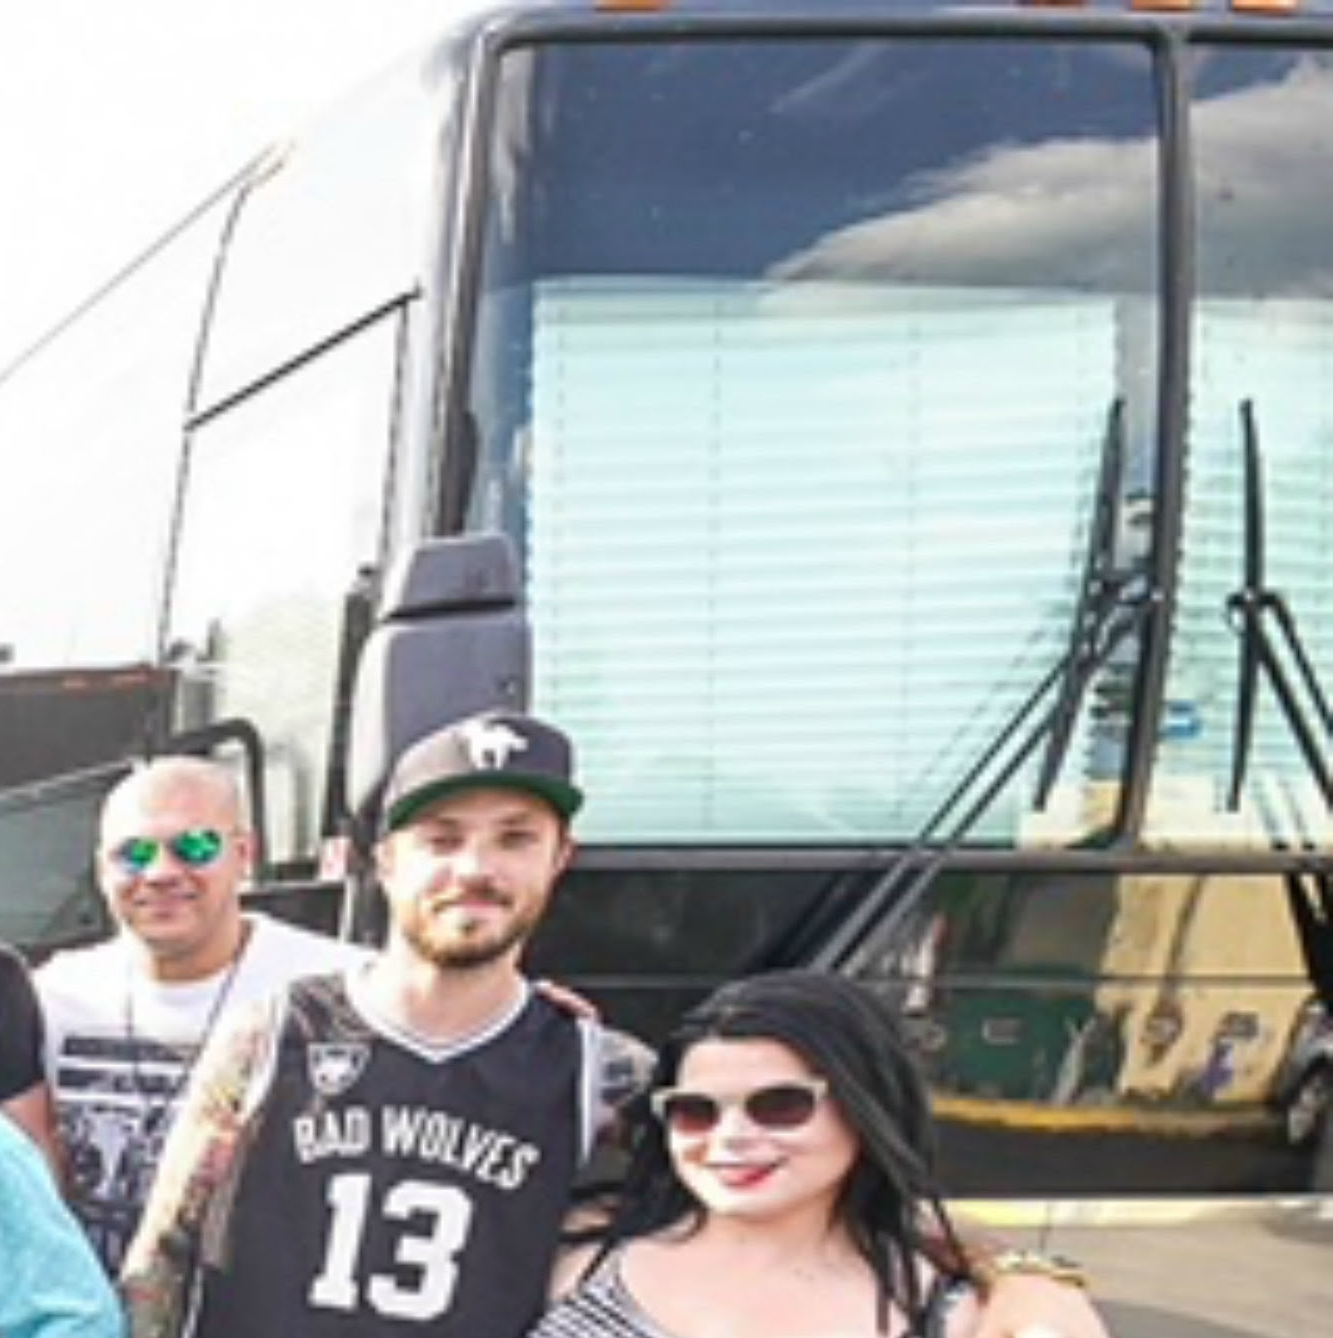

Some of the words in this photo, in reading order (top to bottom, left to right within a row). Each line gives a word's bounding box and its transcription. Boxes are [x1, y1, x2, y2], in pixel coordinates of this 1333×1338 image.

[293, 1106, 371, 1164] BAD
[383, 1104, 541, 1190] WOLVES
[308, 1173, 473, 1321] 13
